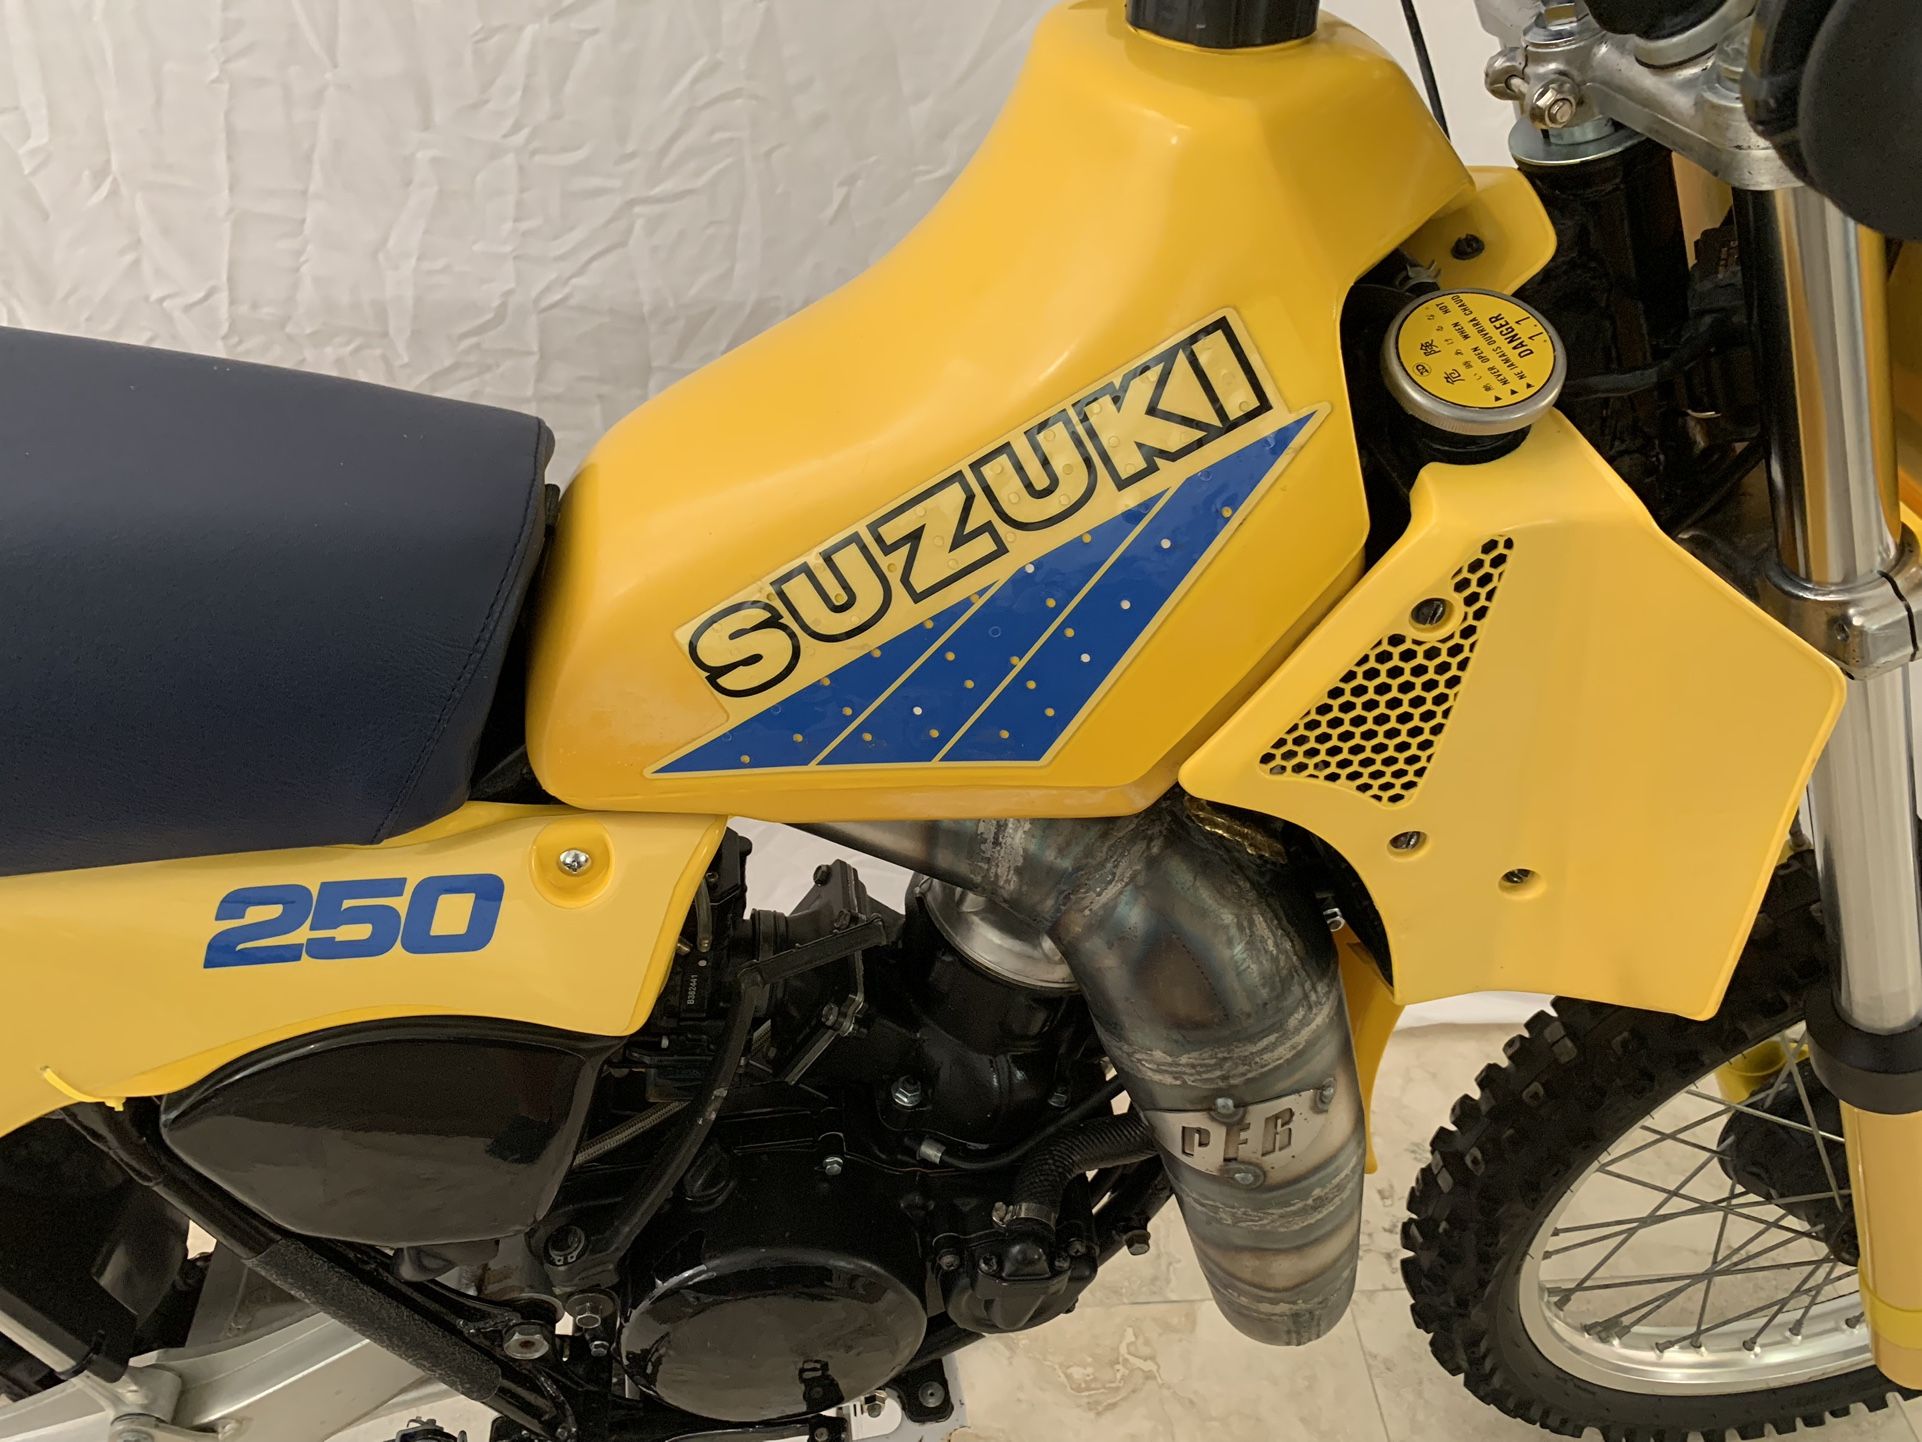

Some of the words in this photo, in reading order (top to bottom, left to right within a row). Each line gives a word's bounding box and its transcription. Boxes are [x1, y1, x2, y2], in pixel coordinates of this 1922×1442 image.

[1435, 302, 1451, 315] HOT
[1451, 294, 1474, 317] CHAUD
[1451, 321, 1471, 341] WHEN
[1488, 313, 1534, 359] DANGER
[1472, 346, 1490, 364] OPEN
[1487, 366, 1511, 387] NEVER
[1514, 371, 1527, 381] NE
[688, 315, 1273, 698] SUZUKI
[203, 873, 506, 969] 250
